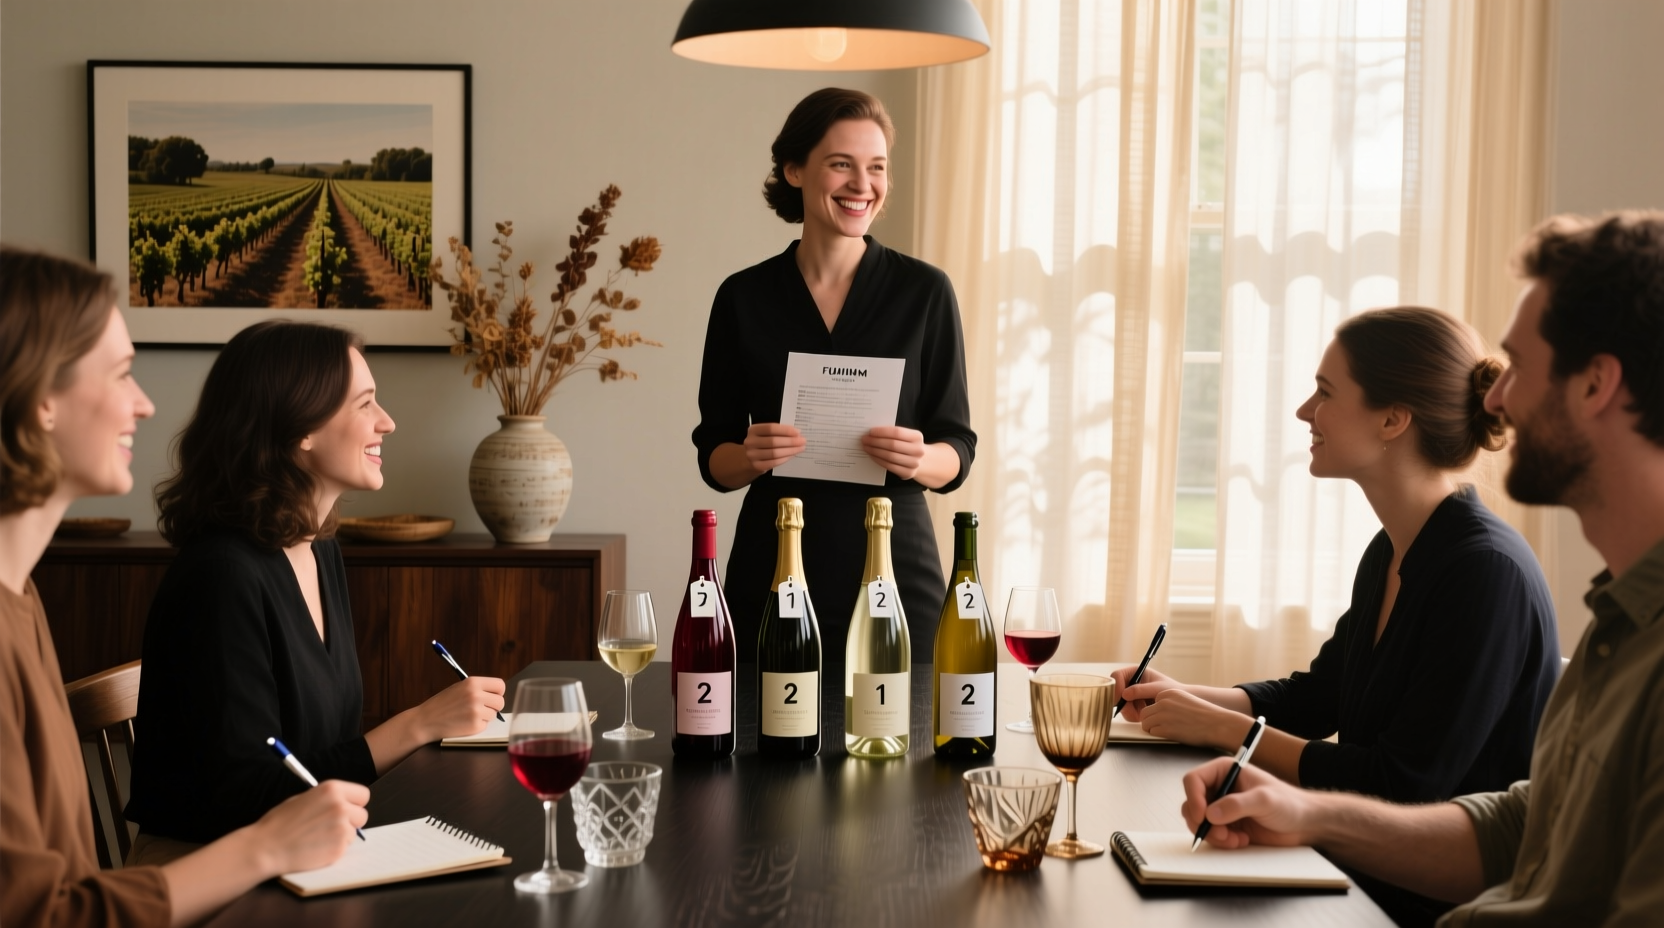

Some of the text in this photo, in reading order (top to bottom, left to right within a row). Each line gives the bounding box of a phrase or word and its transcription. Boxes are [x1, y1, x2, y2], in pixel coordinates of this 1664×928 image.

[787, 592, 795, 608] 1
[876, 592, 887, 608] 2
[963, 593, 975, 609] 2
[697, 682, 712, 704] 2
[783, 682, 798, 704] 2
[875, 683, 885, 705] 1
[961, 683, 975, 705] 2
